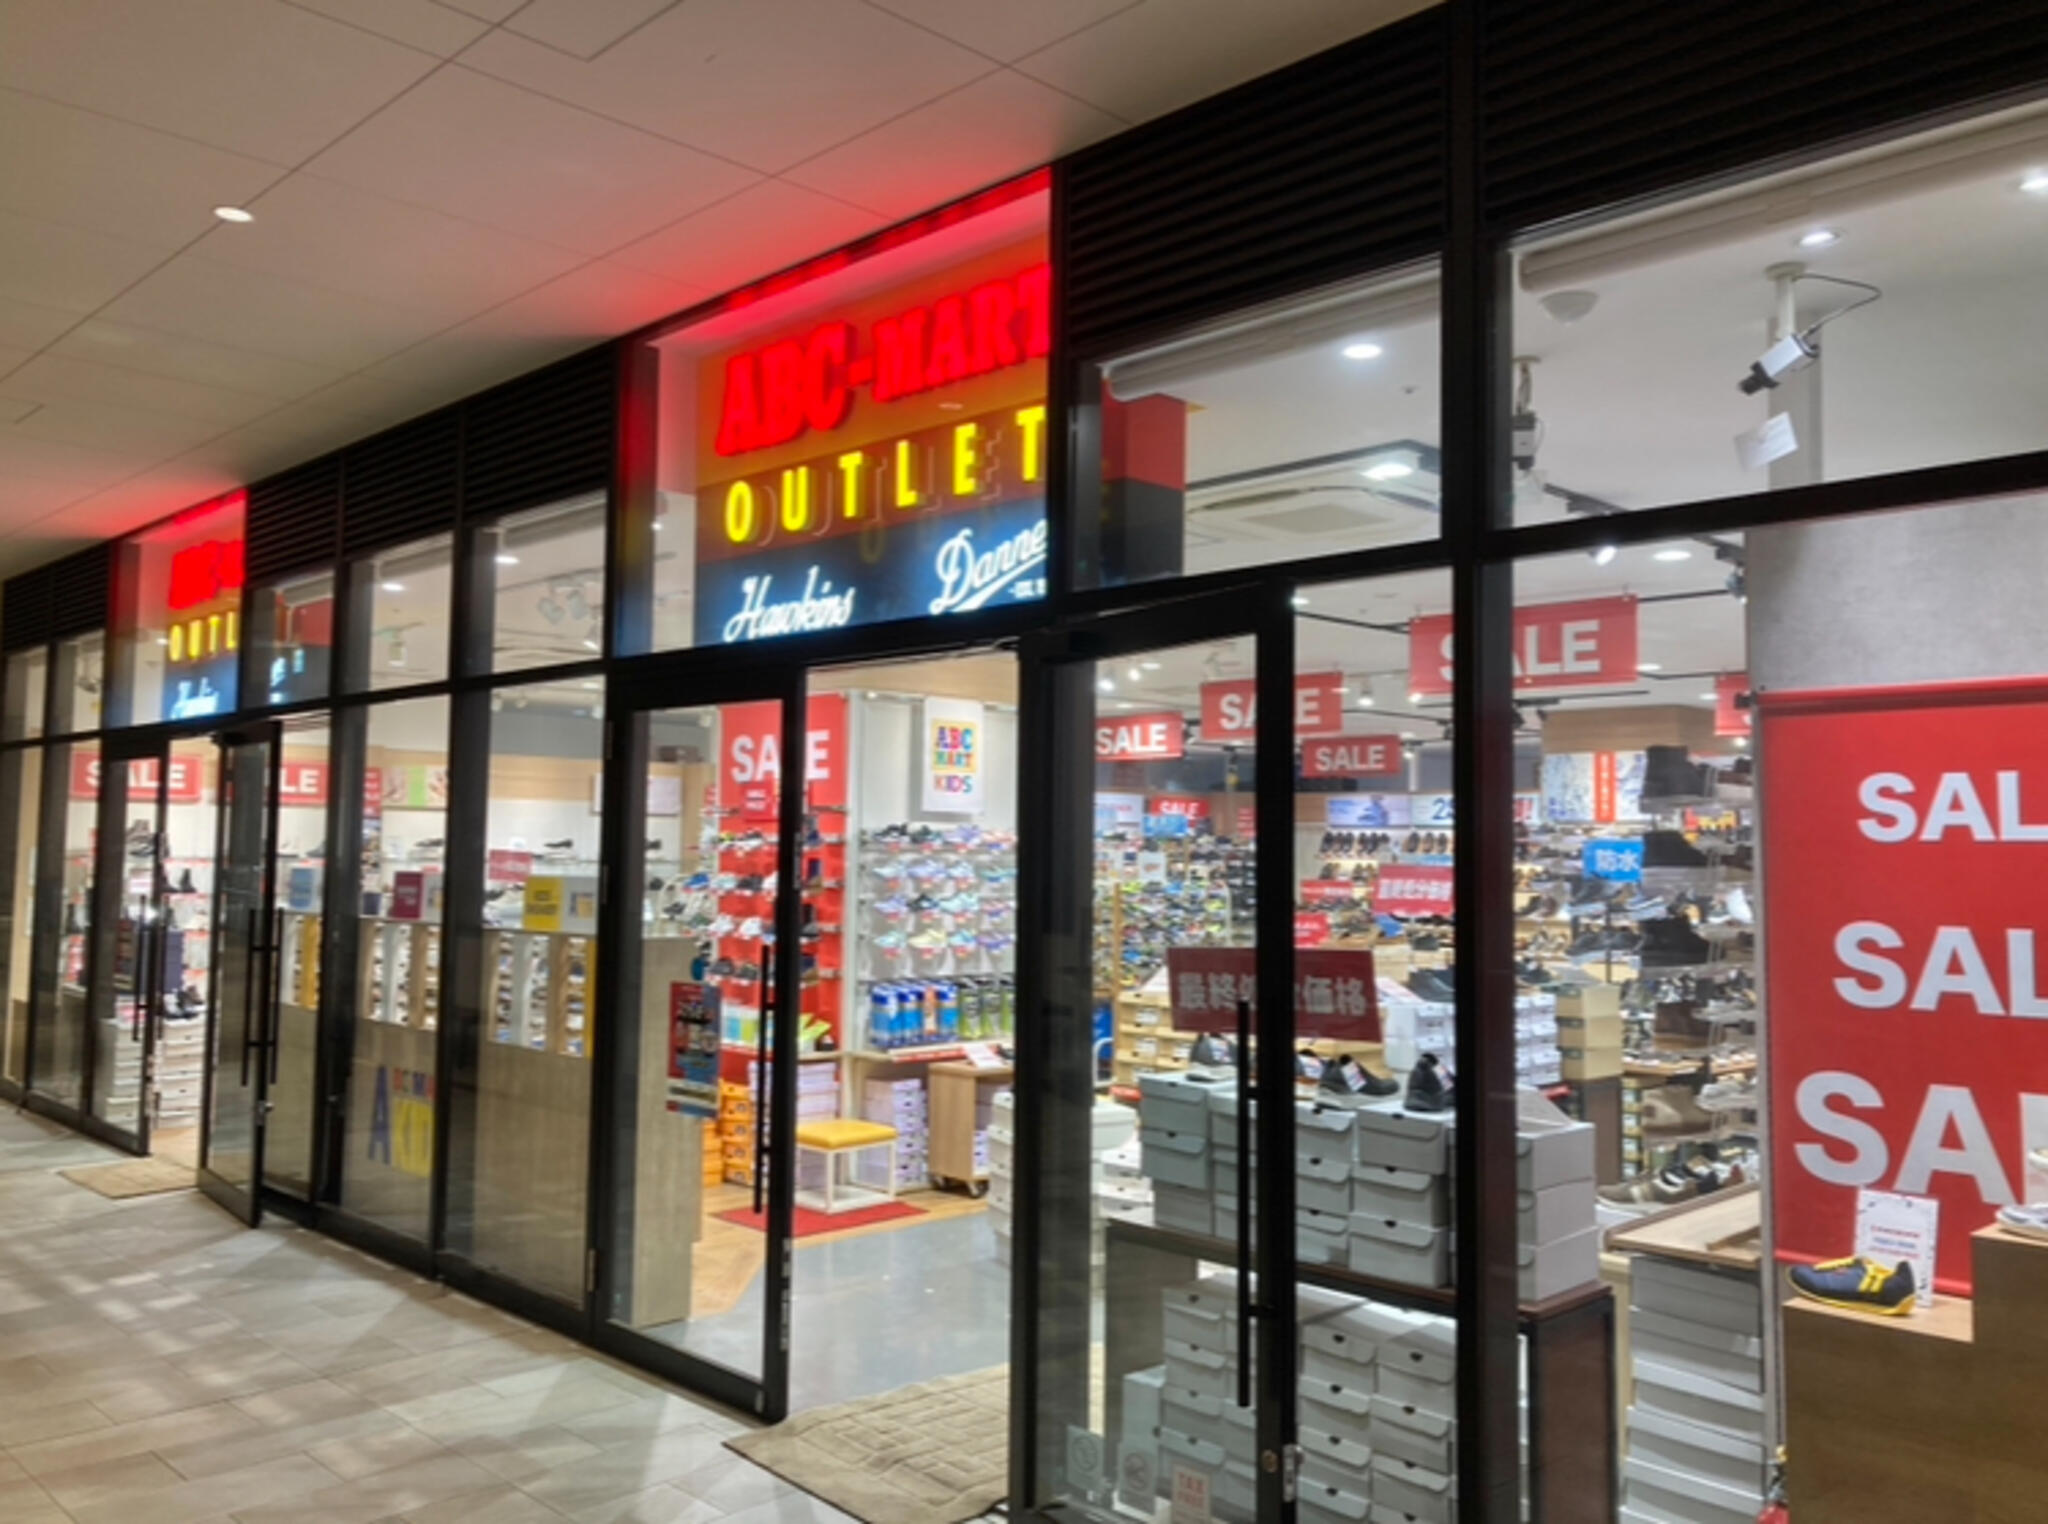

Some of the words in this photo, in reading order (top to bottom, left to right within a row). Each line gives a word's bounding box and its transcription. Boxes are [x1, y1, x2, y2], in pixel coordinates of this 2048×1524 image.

[715, 262, 1051, 456] ABC-MART
[725, 405, 1045, 543] OUTLET
[929, 517, 1047, 614] Danne
[722, 565, 856, 643] Hawkins
[1440, 619, 1602, 680] LE
[1219, 688, 1321, 731] SE
[731, 729, 831, 785] SAE
[934, 726, 974, 751] ABC
[1095, 723, 1167, 755] SALE
[1315, 745, 1386, 772] SALE
[86, 763, 186, 790] SLE
